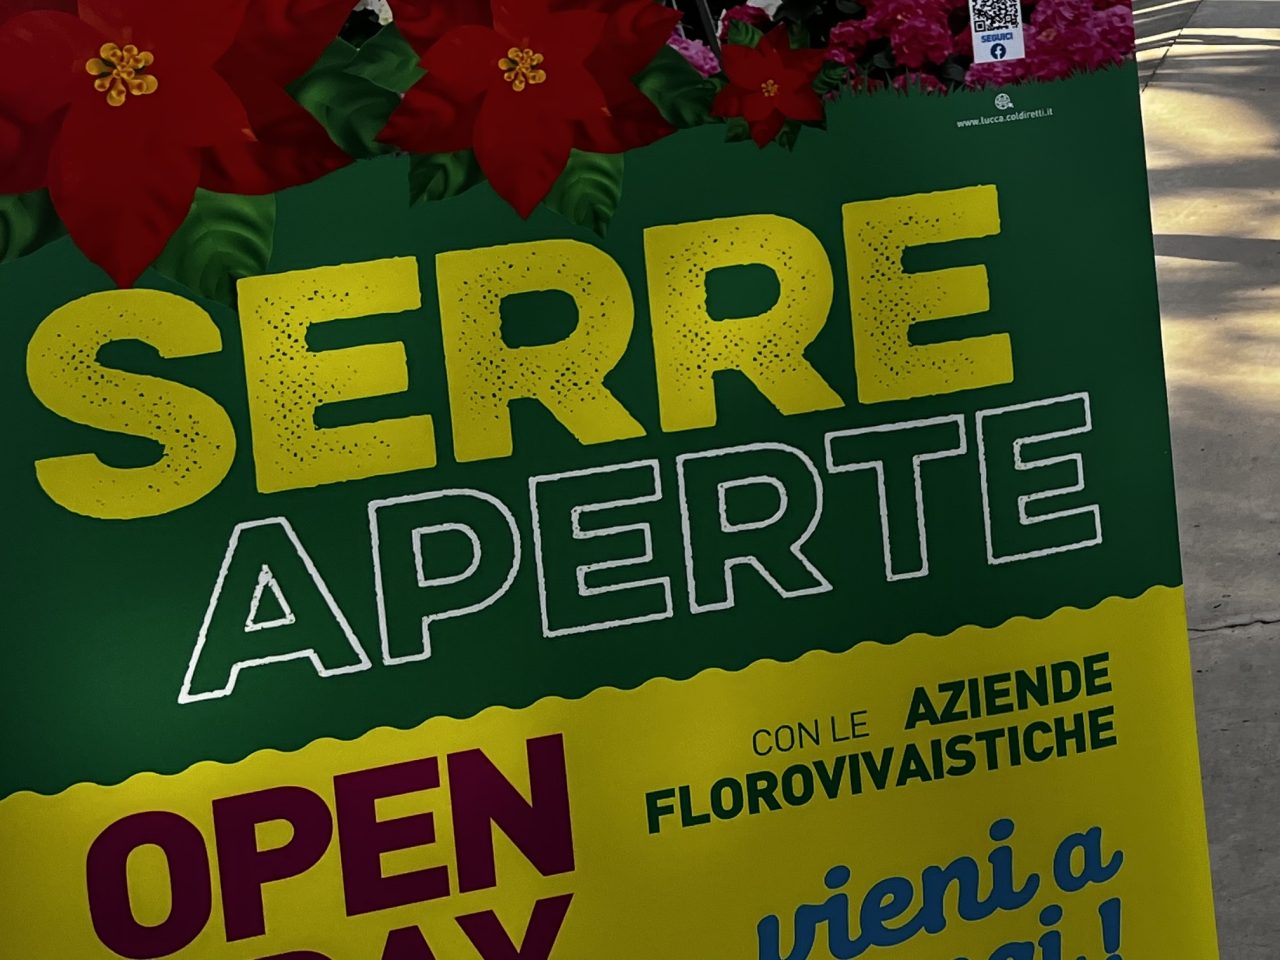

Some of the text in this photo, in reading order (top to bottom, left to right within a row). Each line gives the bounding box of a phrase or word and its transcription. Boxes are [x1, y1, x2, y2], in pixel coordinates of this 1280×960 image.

[981, 32, 1013, 43] SEGUICI
[957, 108, 1053, 127] www.lucca.coldiretti.it
[26, 184, 1014, 520] SERRE
[178, 391, 1103, 704] APERTE
[645, 705, 1118, 834] FLOROVIVAISTICHE
[752, 652, 1113, 756] CON LE AZIENDE
[86, 732, 576, 960] OPEN
[756, 818, 1040, 960] vieni
[1053, 825, 1124, 892] a
